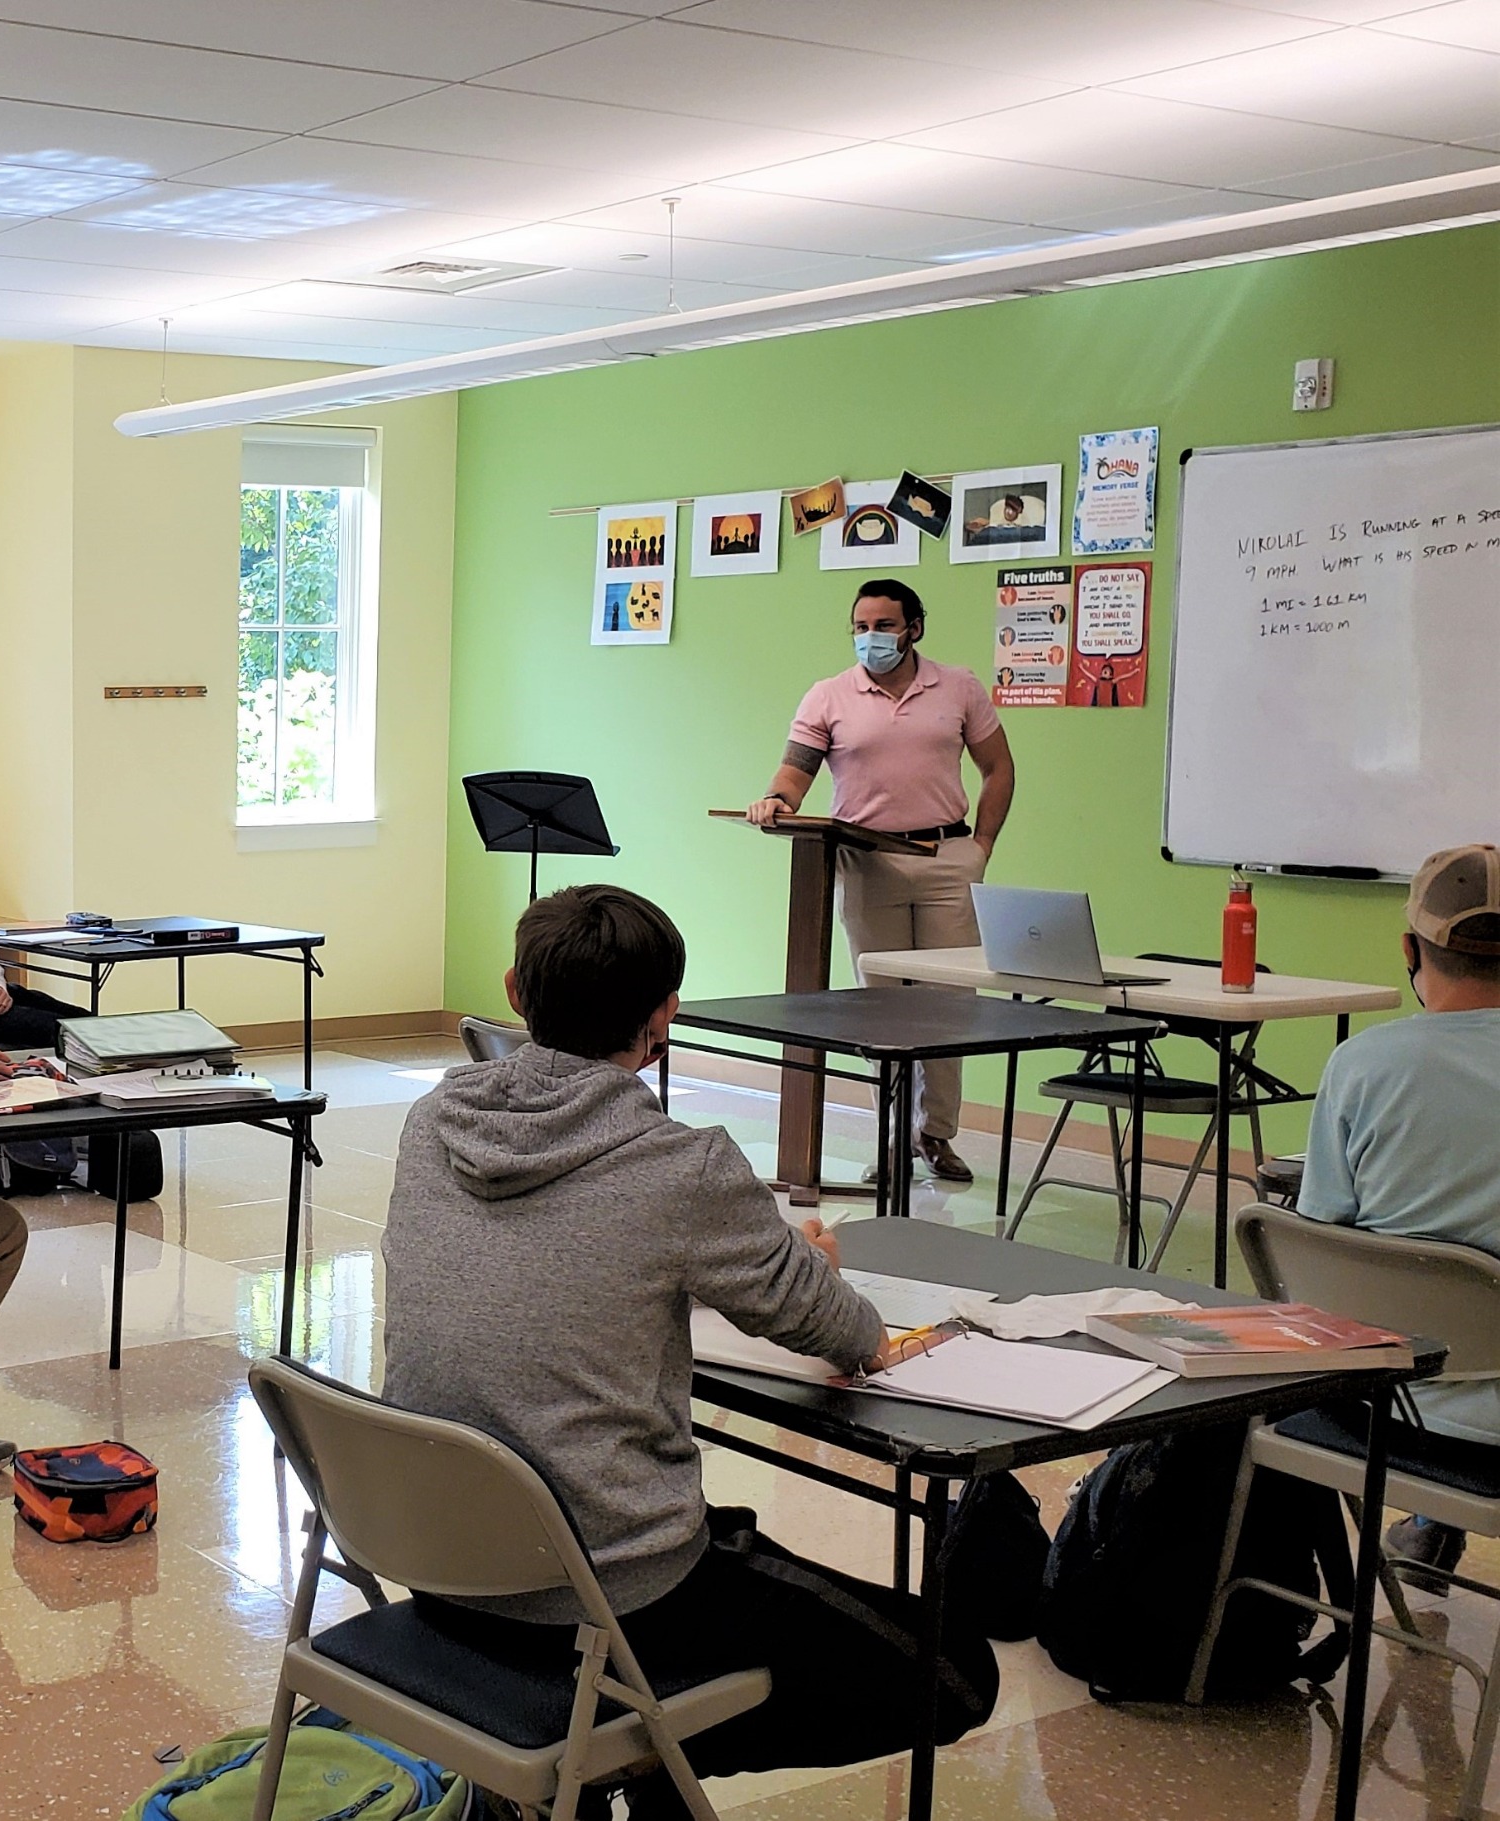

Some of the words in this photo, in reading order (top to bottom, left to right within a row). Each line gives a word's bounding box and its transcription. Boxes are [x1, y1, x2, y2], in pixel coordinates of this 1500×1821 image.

[1092, 483, 1118, 492] MEMORY
[1120, 481, 1140, 490] VERSE
[1329, 523, 1347, 541] IS
[1362, 519, 1421, 537] RUNNING
[1432, 516, 1447, 528] AT
[1457, 514, 1466, 524] A
[1245, 566, 1256, 582] 9
[1322, 555, 1363, 572] WHAT
[1375, 552, 1384, 564] IS
[1396, 549, 1412, 562] HIS
[1422, 543, 1458, 558] SPEED
[1004, 572, 1028, 585] Five
[1029, 570, 1065, 584] truths
[1099, 574, 1109, 583] DO
[1111, 574, 1124, 583] NOT
[1261, 598, 1271, 613] 1
[1348, 592, 1367, 603] KM
[1102, 611, 1120, 619] SHALL
[1260, 624, 1268, 637] 1
[1270, 622, 1290, 635] KM
[1306, 621, 1334, 633] 1000
[1081, 639, 1093, 647] YOU
[1009, 688, 1023, 697] part
[1024, 687, 1032, 696] of
